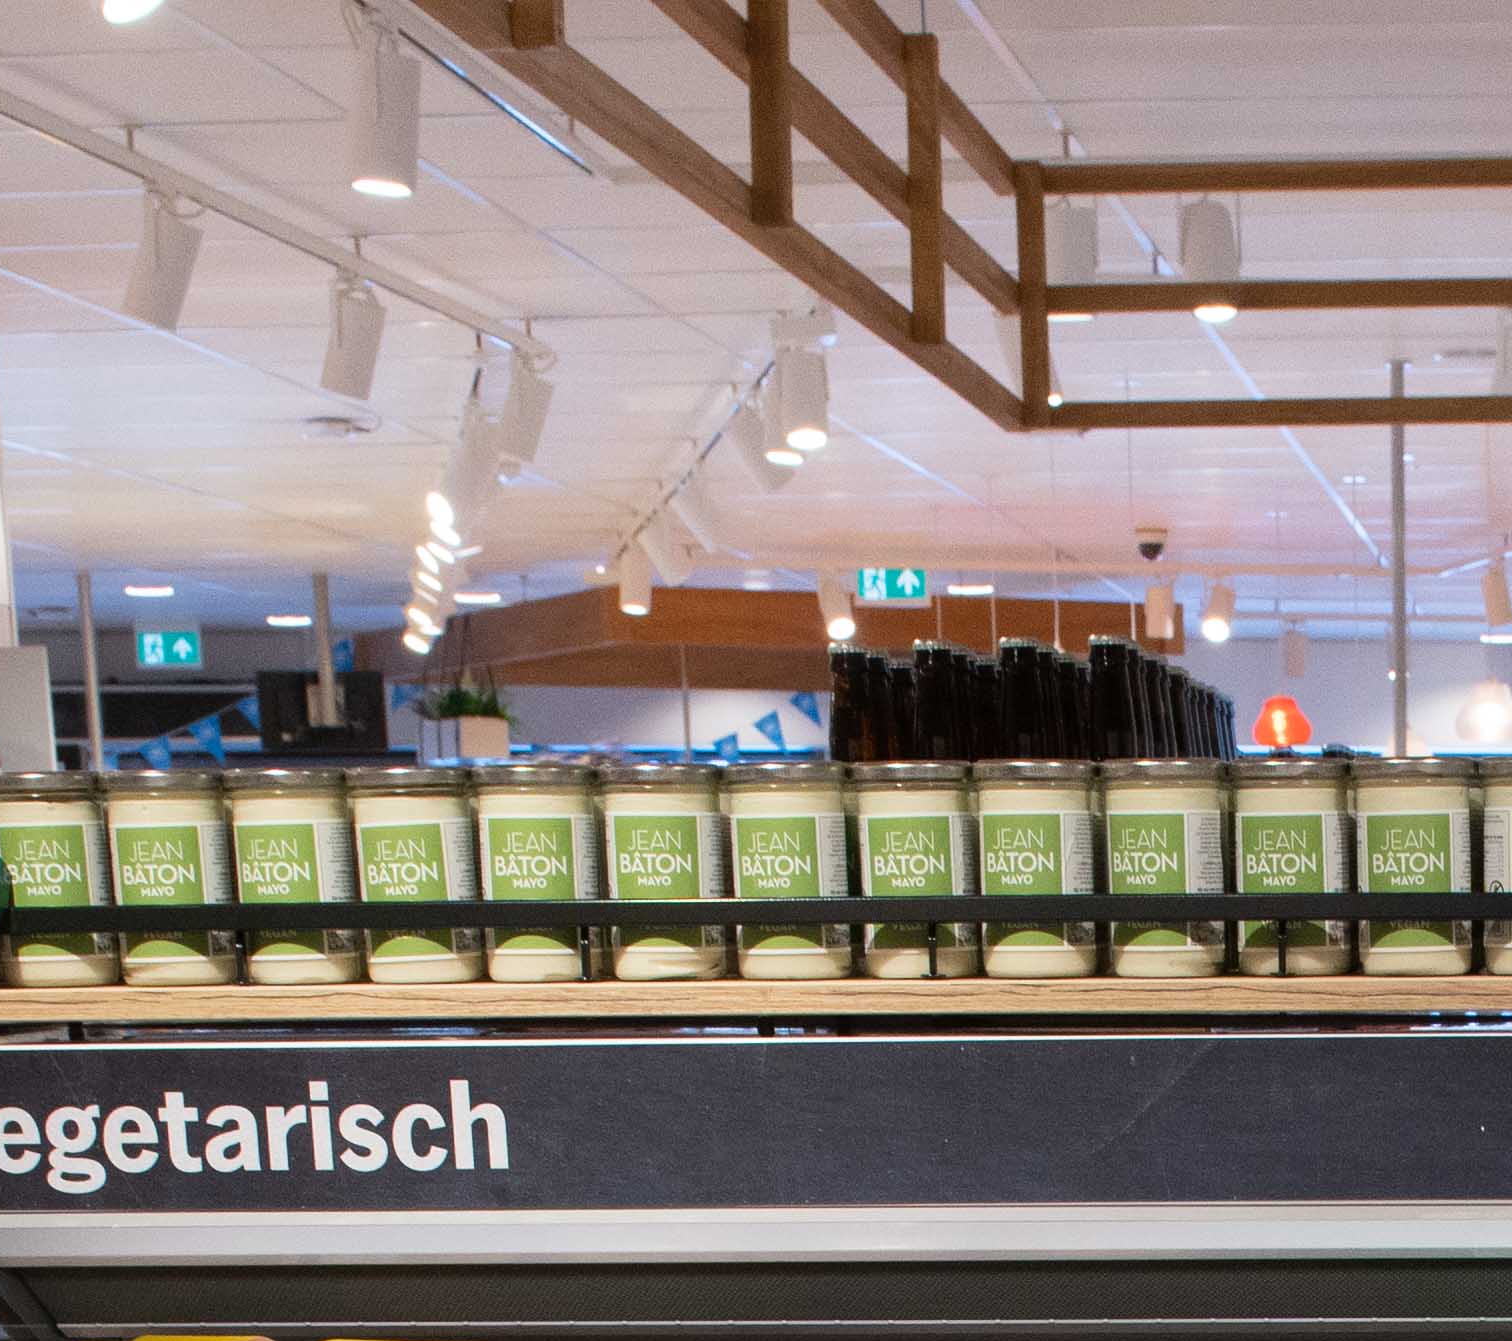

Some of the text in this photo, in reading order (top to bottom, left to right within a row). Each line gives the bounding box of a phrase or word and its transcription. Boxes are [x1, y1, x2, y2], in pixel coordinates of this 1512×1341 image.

[128, 840, 185, 862] JEAN
[627, 829, 682, 851] JEAN
[122, 861, 196, 885] BÂTON
[620, 852, 692, 874] BÂTON
[140, 885, 174, 897] MAYO
[637, 875, 671, 887] MAYO
